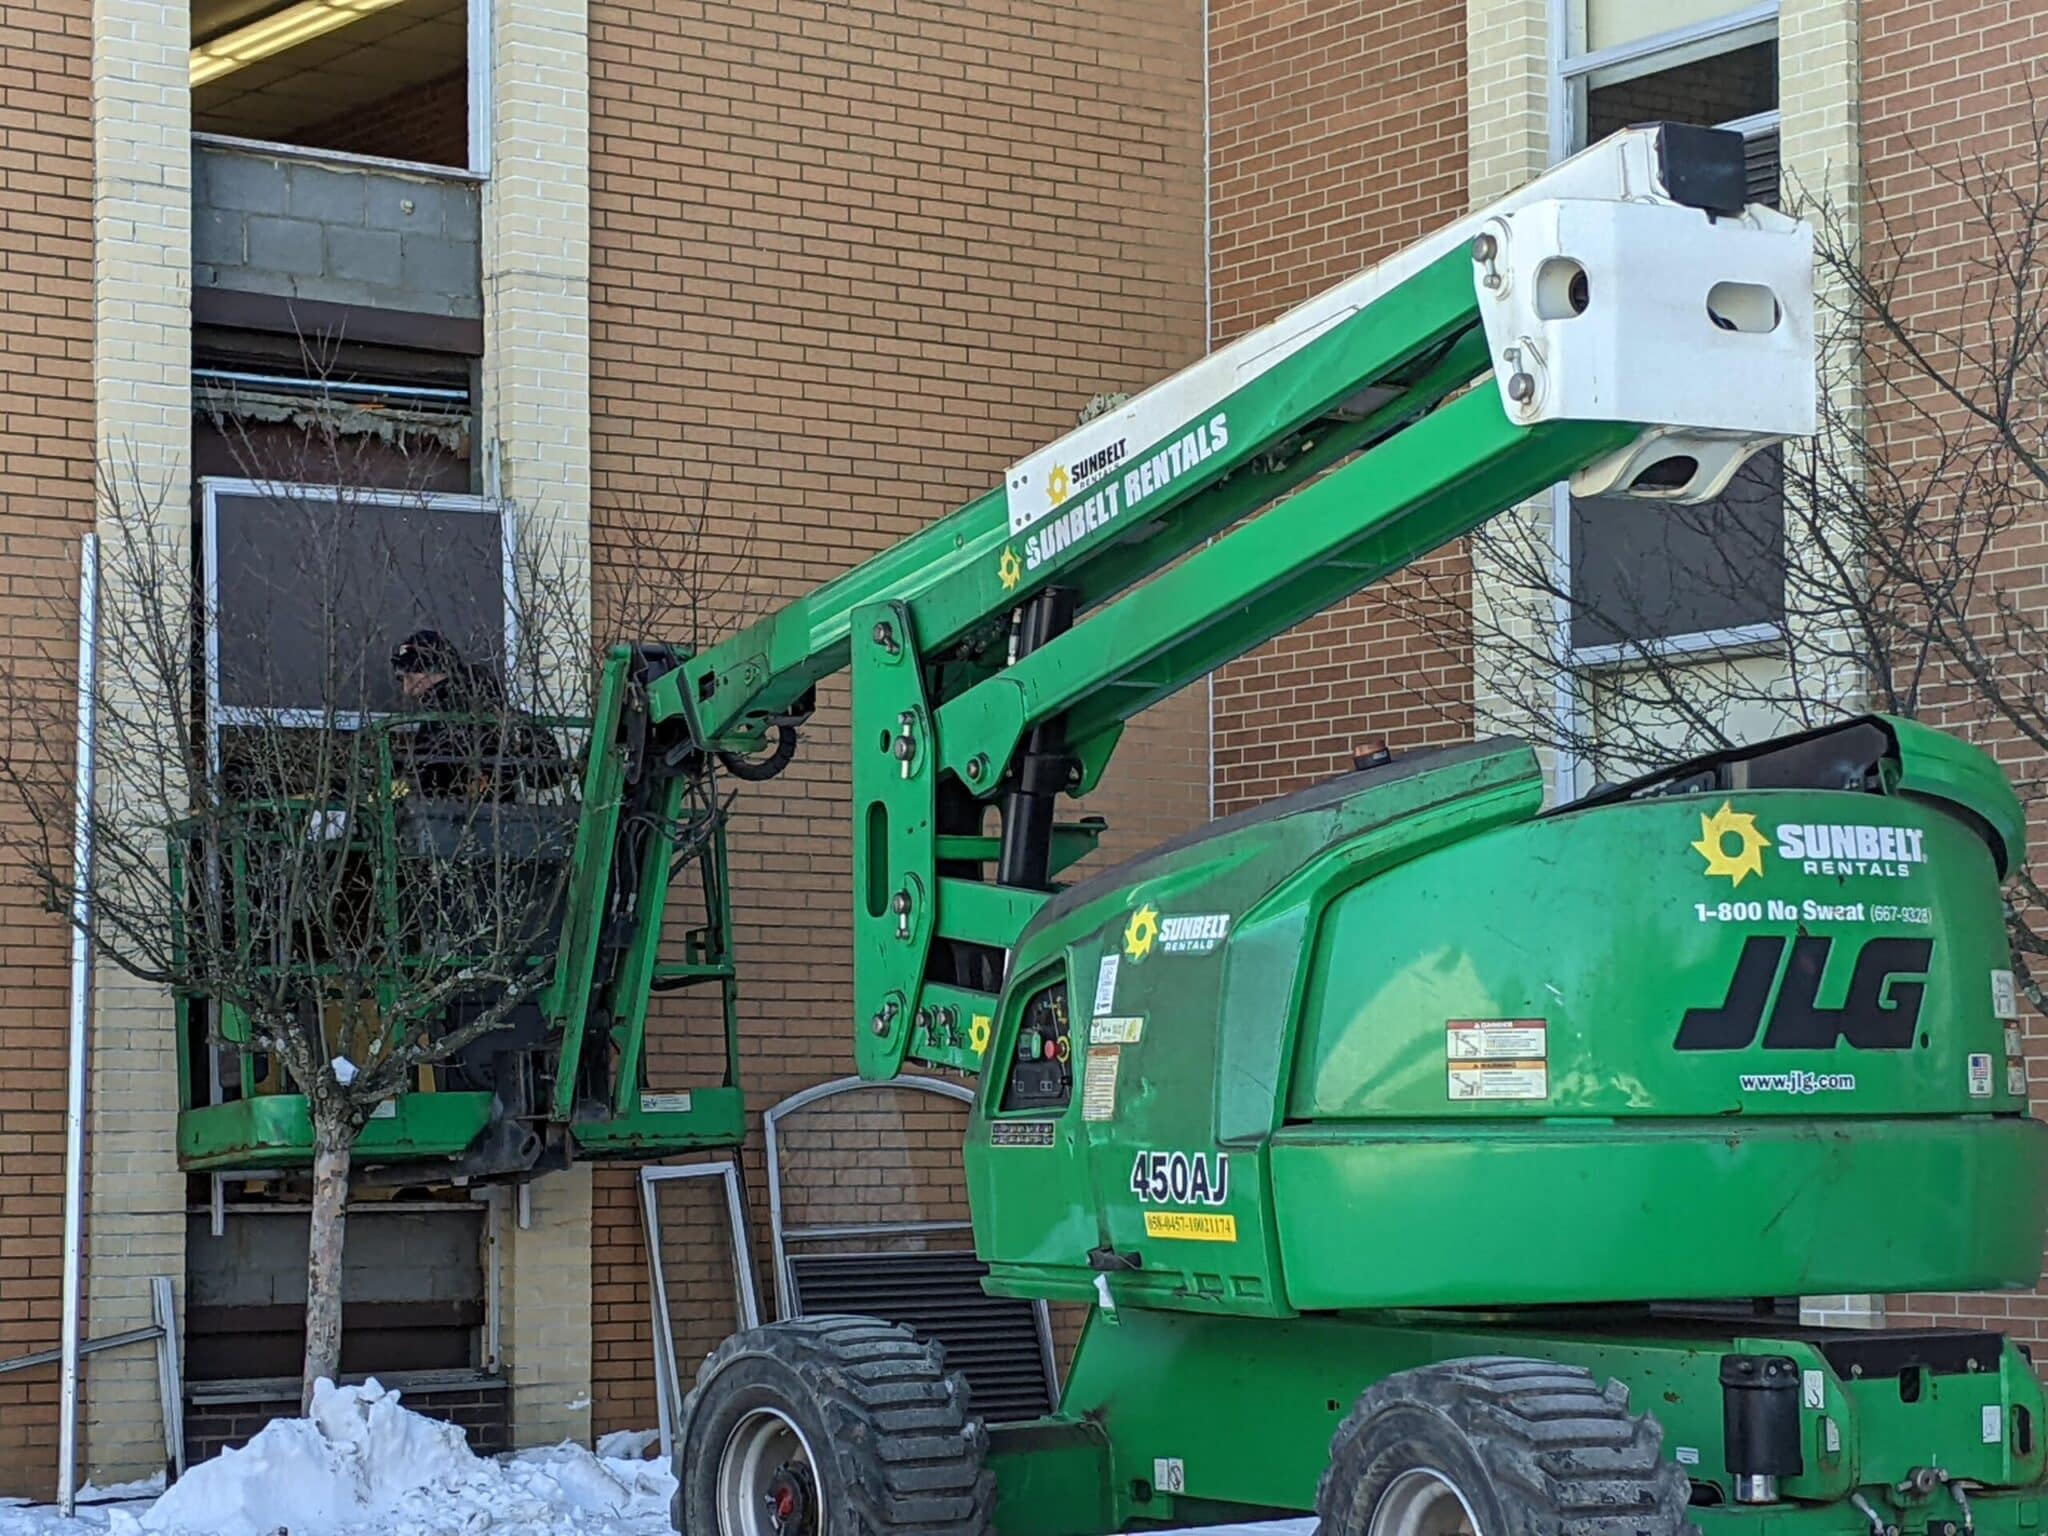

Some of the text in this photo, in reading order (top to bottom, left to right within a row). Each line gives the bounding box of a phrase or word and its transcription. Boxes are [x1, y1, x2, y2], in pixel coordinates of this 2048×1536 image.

[1071, 437, 1126, 484] SUNBELT
[1025, 412, 1228, 571] SUNBELT RENTALS
[1776, 823, 1923, 862] SUNBELT
[1803, 860, 1909, 877] RENTALS
[1158, 913, 1230, 942] SUNBELT
[1694, 902, 1762, 922] 1-800
[1767, 900, 1798, 921] No
[1802, 899, 1865, 921] Sweat
[1164, 939, 1214, 952] RENTALS
[1673, 935, 1934, 1050] JLG
[1740, 1070, 1855, 1094] www.jlg.com
[1131, 1151, 1229, 1205] 450AJ
